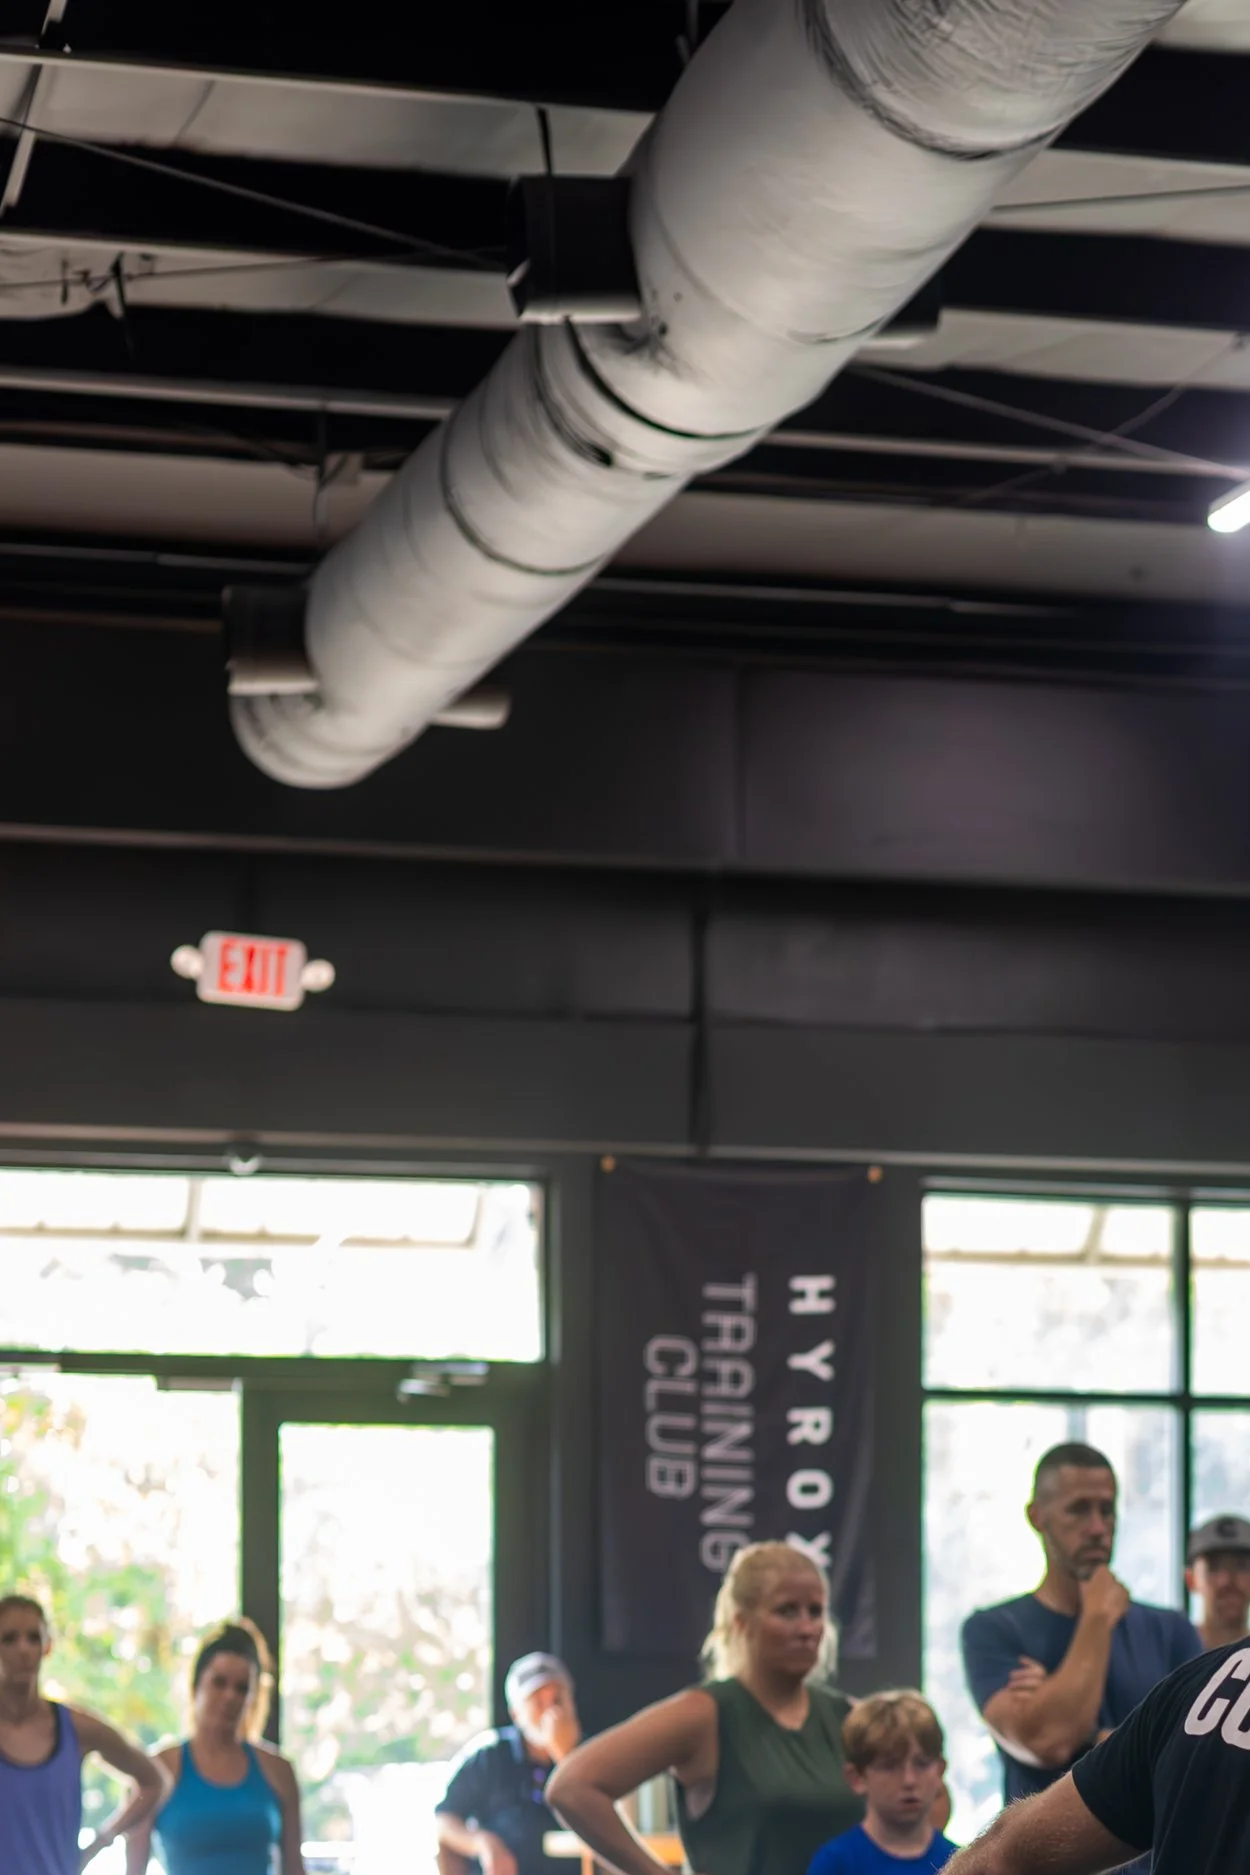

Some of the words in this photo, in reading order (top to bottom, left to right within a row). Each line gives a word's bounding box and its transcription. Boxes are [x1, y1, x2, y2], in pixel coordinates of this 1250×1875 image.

[218, 937, 289, 996] EXIT
[644, 1335, 698, 1499] CLUB
[699, 1273, 756, 1572] TRAINING
